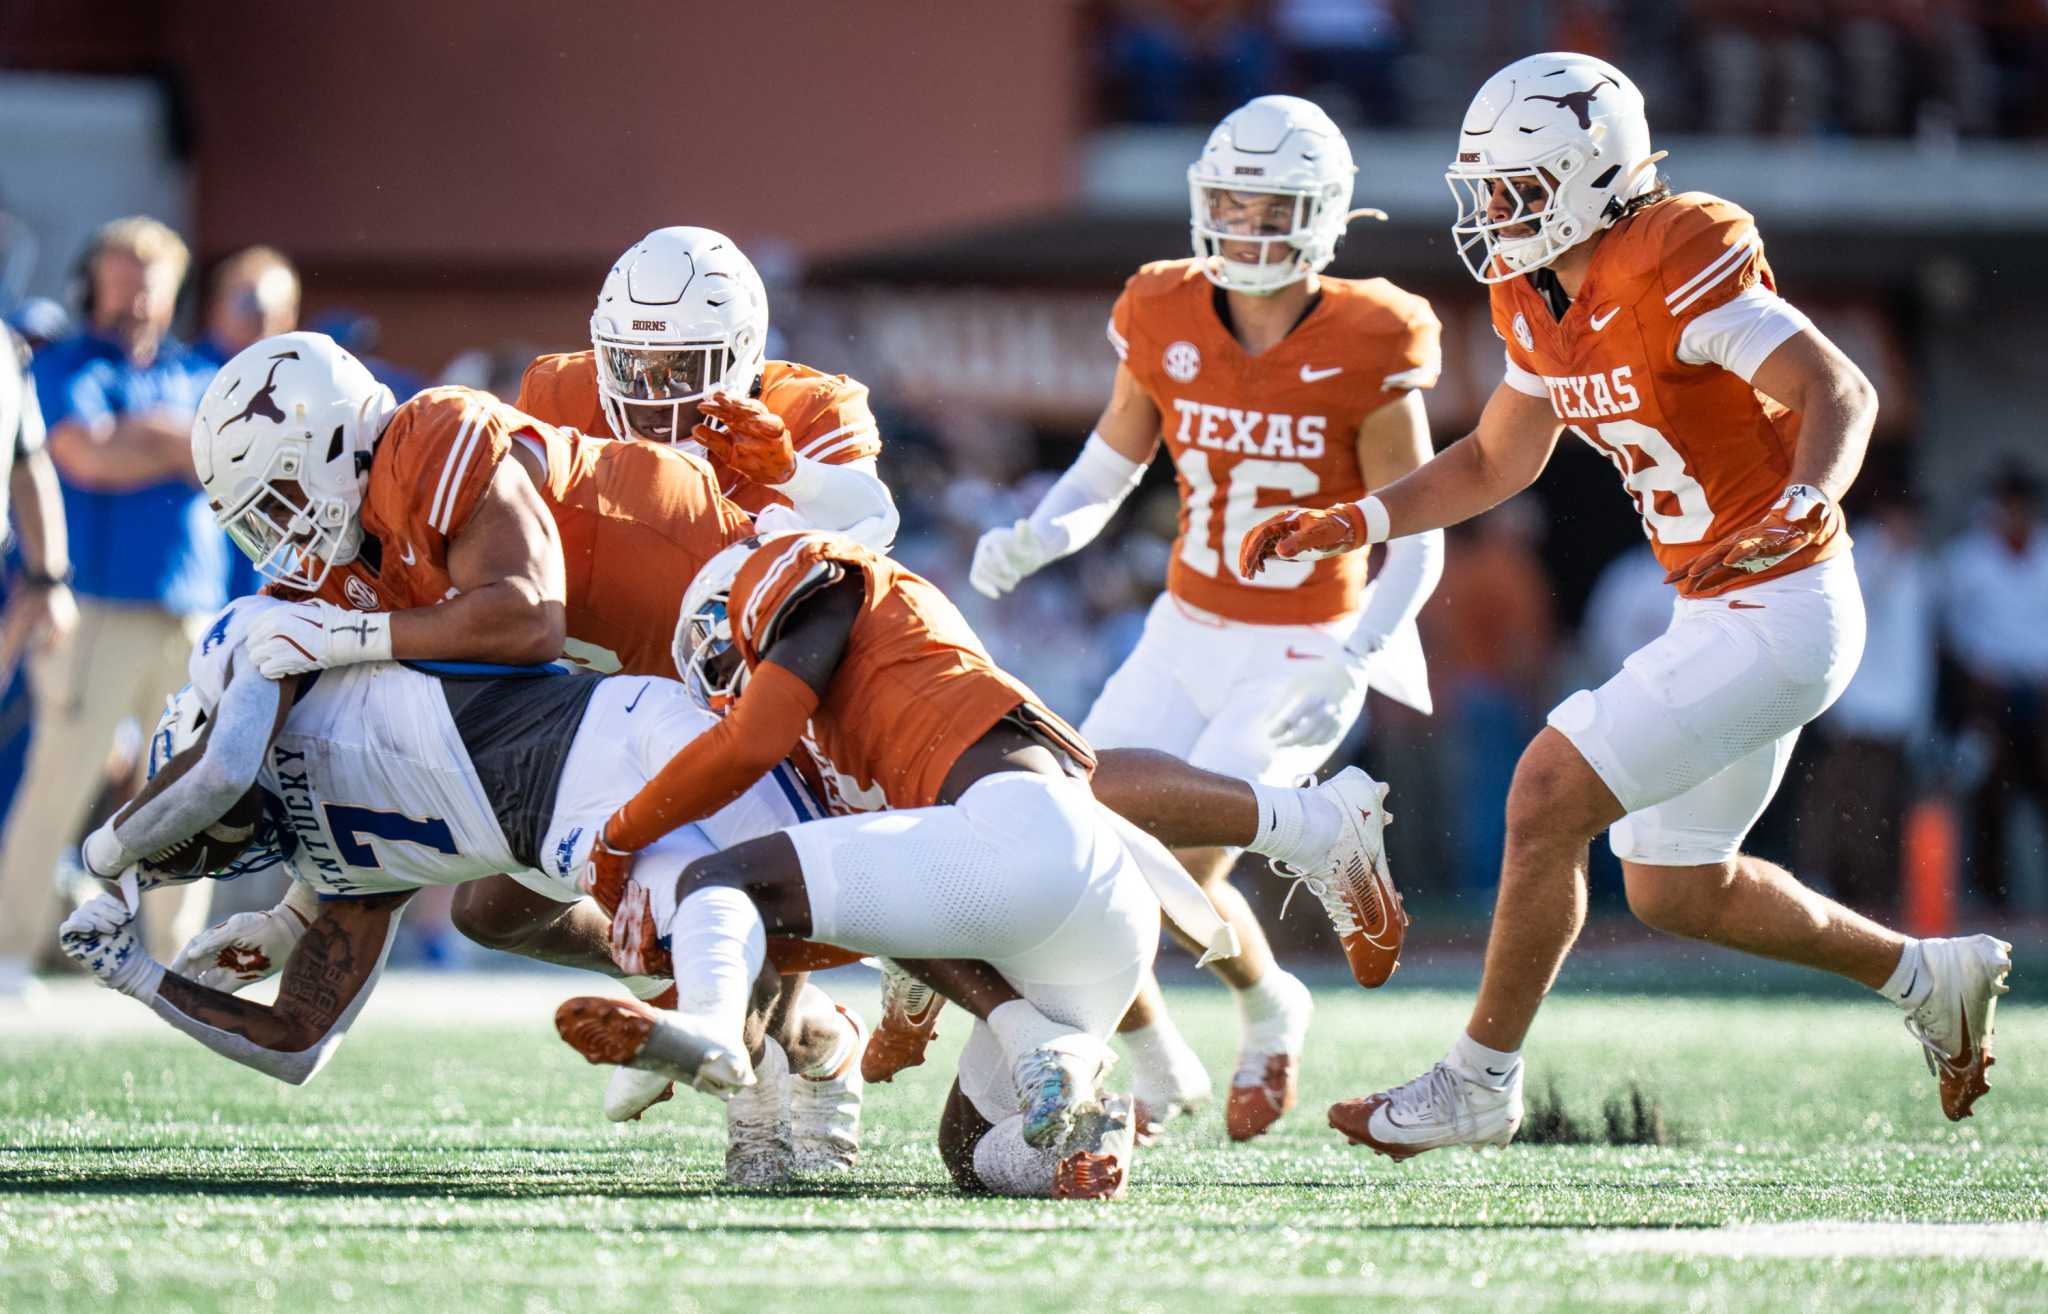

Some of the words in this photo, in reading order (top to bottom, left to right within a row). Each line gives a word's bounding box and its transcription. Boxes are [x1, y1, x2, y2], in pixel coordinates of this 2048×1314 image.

[632, 319, 666, 332] HORNS
[1542, 365, 1640, 419] TEXAS
[1172, 398, 1327, 459] TEXAS
[1178, 448, 1320, 589] 16
[320, 800, 465, 870] 7
